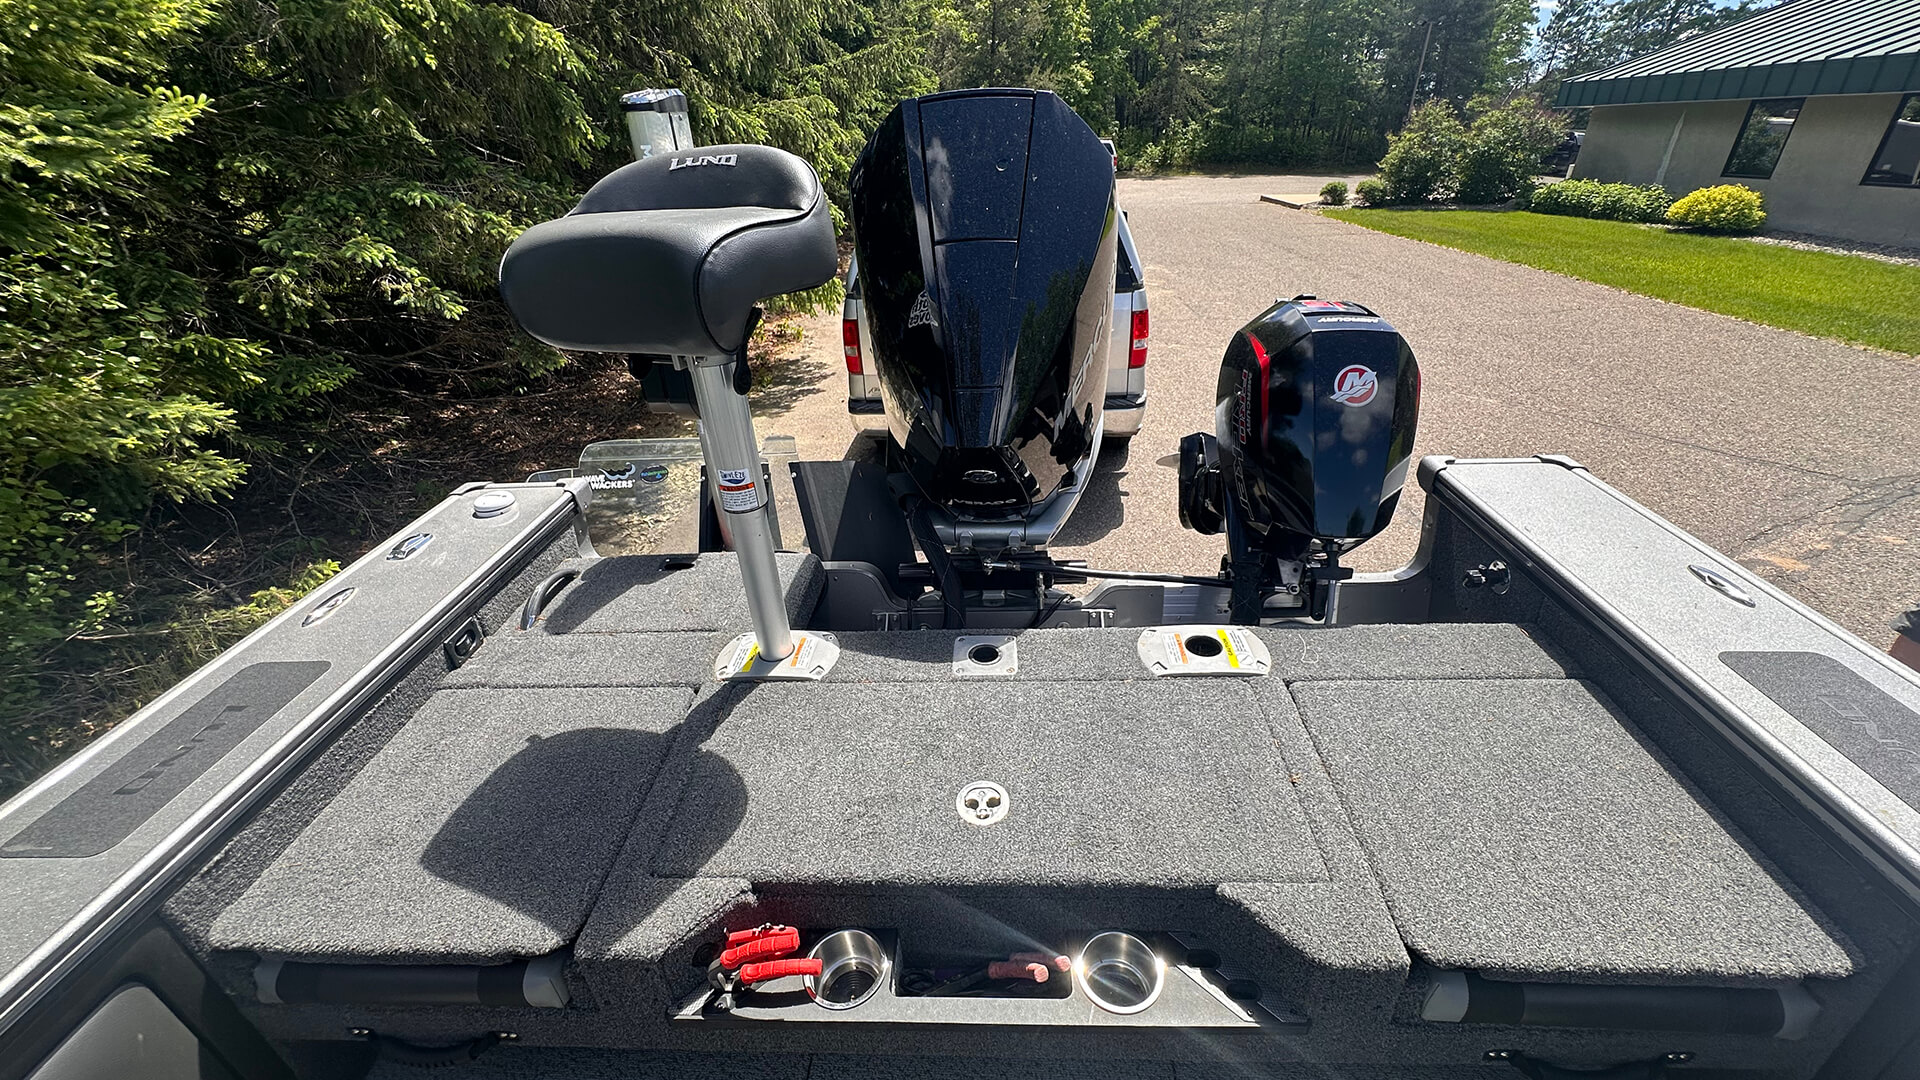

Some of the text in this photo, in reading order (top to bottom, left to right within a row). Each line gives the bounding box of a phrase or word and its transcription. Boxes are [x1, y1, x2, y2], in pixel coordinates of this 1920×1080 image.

[669, 154, 738, 171] LUND
[1318, 316, 1379, 324] MERCURY
[1246, 373, 1254, 437] MERCURY
[582, 474, 606, 482] WAVE
